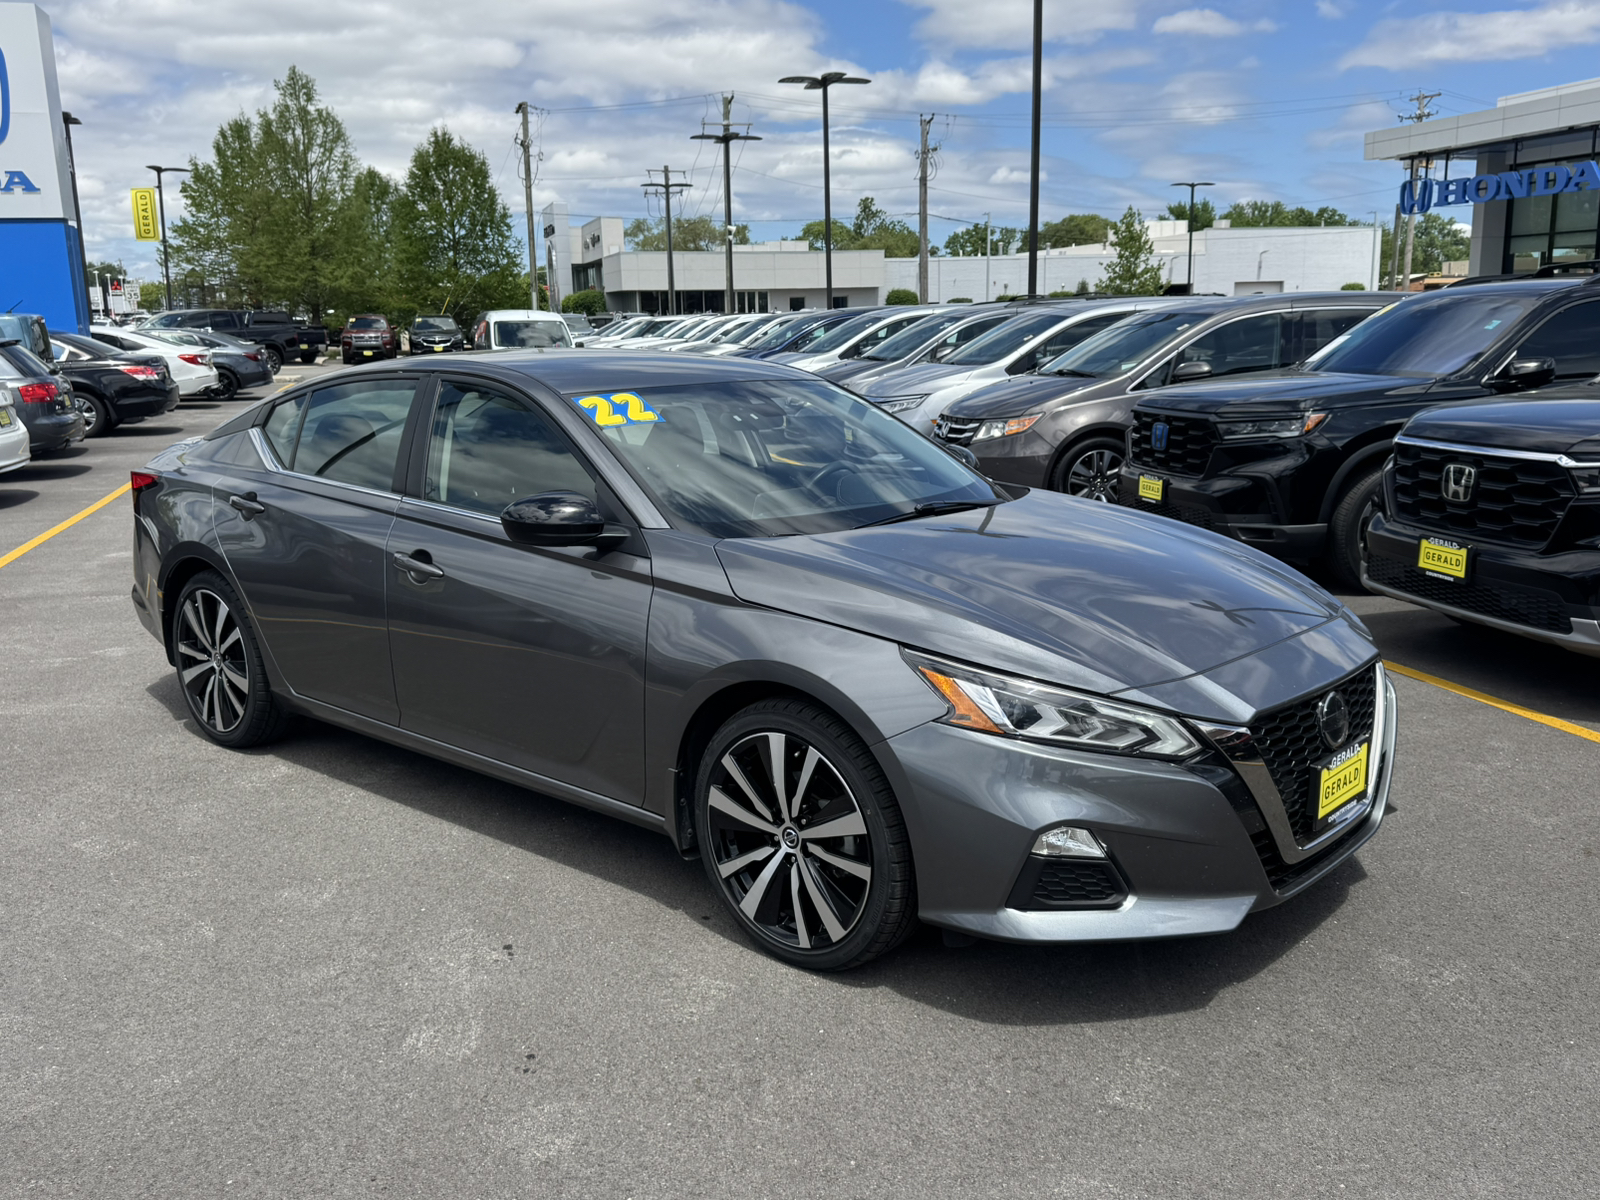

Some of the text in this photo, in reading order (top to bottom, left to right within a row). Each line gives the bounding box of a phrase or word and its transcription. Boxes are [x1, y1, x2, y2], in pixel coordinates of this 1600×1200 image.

[1433, 160, 1600, 207] HONDA
[140, 194, 151, 235] GERALD
[578, 393, 659, 426] 22
[1142, 484, 1160, 493] GERALD
[1425, 551, 1461, 567] GERALD
[1324, 767, 1359, 800] GERALD
